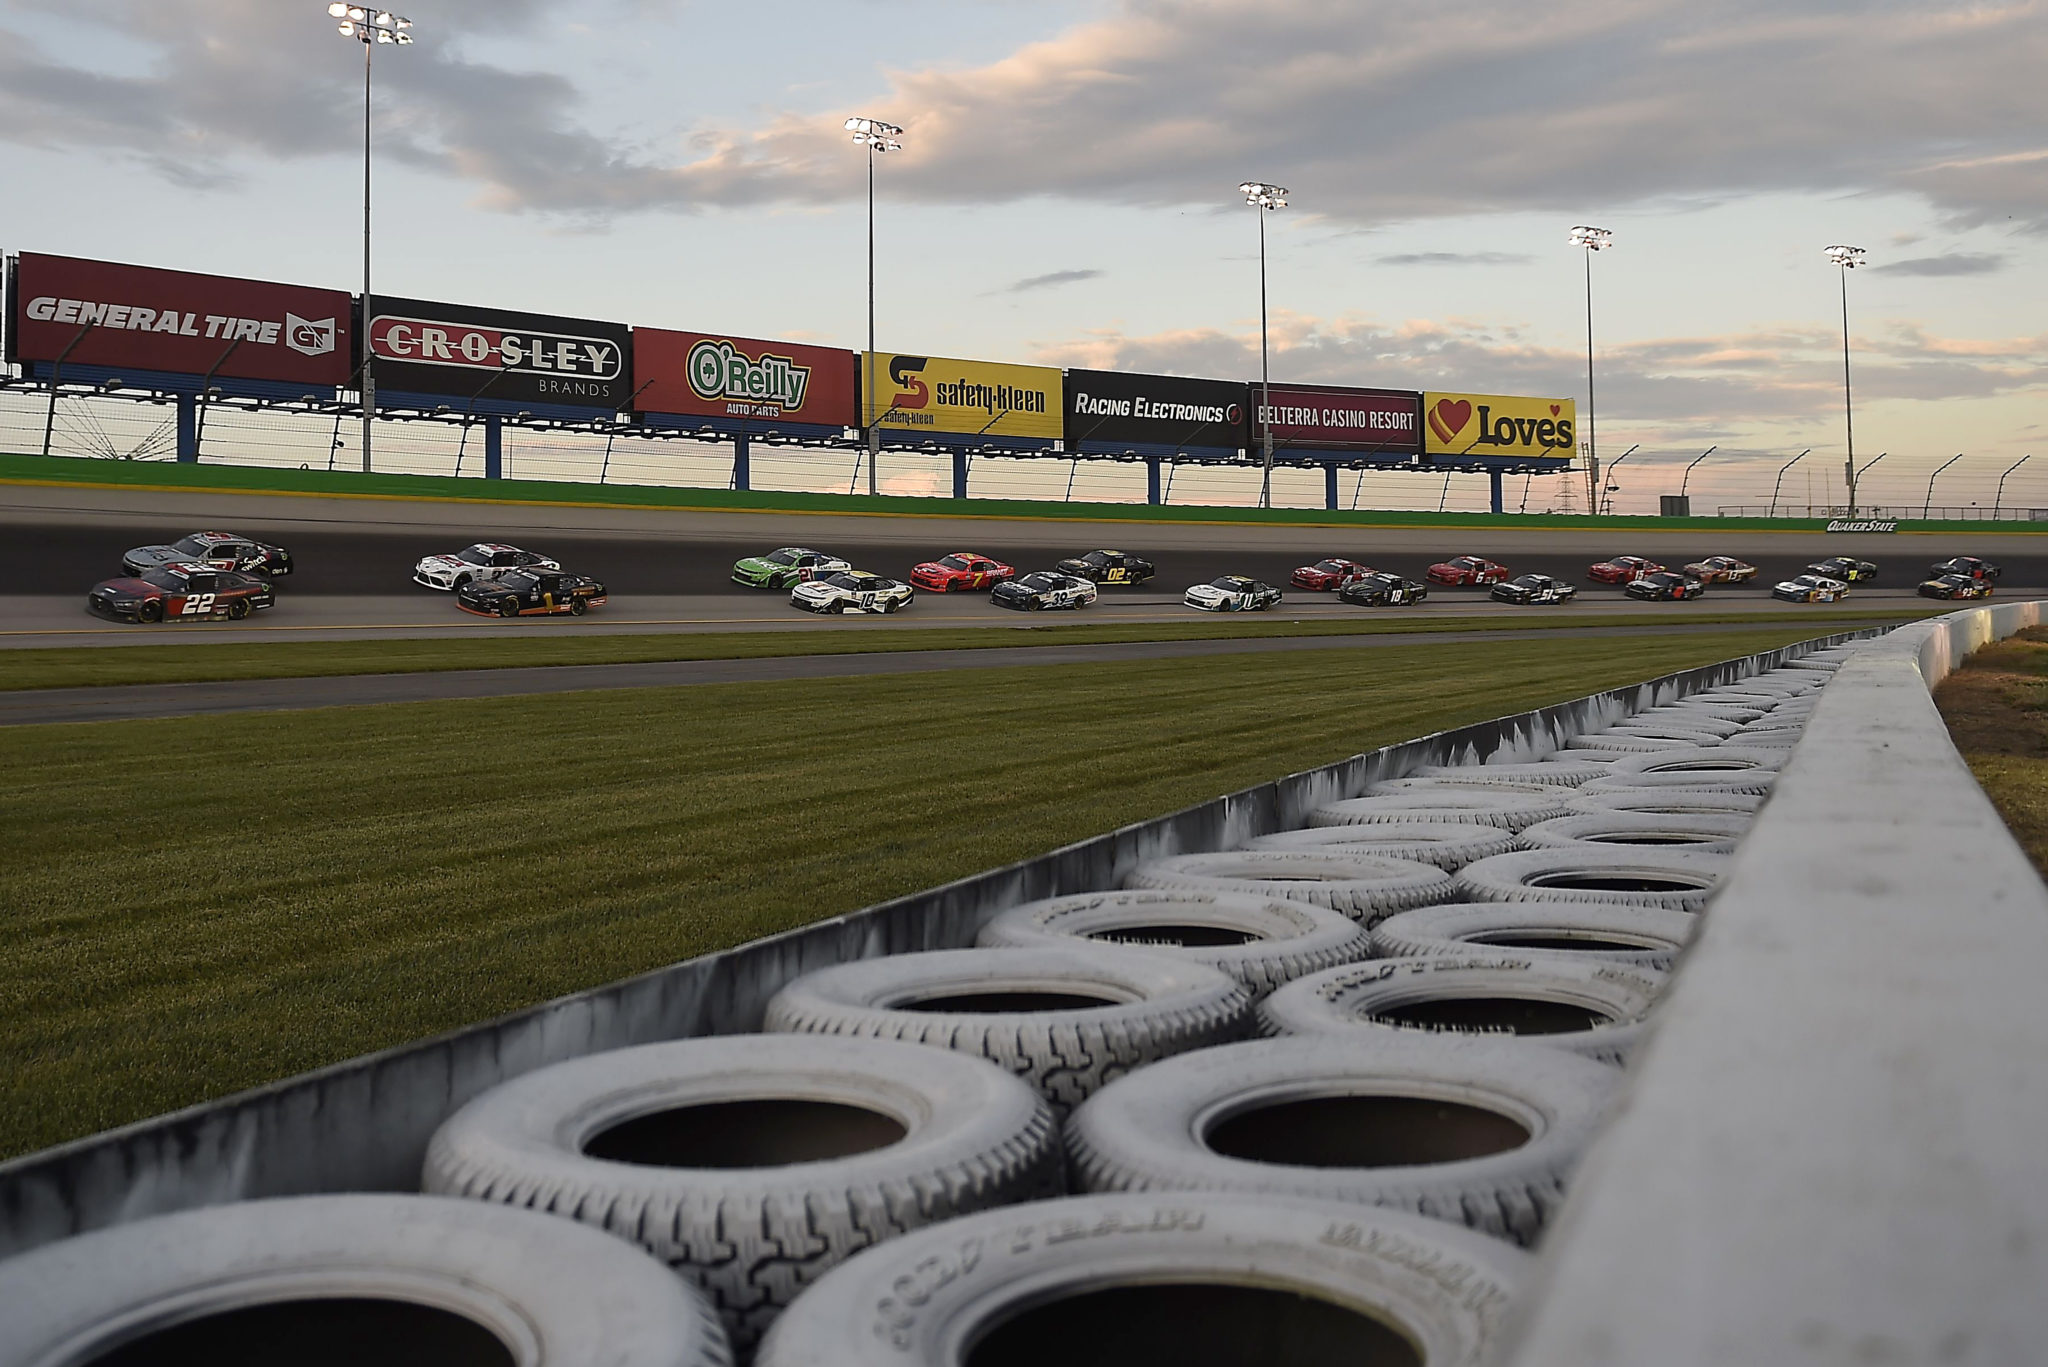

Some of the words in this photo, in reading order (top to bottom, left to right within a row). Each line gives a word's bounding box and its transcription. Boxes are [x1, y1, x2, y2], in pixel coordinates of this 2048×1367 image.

[26, 297, 198, 336] GENERAL
[205, 315, 282, 344] TIRE
[387, 325, 611, 373] CROSLEY
[693, 348, 803, 404] O'Reilly
[539, 379, 610, 397] BRANDS
[727, 403, 750, 415] AUTO
[1075, 393, 1131, 417] RACING
[1134, 397, 1224, 423] ELECTRONICS
[1258, 405, 1319, 426] BELTERRA
[1322, 409, 1365, 428] CASINO
[1370, 411, 1414, 430] RESORT
[799, 567, 813, 582] 21
[972, 572, 984, 587] 7
[1108, 567, 1125, 581] 02
[1475, 572, 1485, 583] 6
[543, 592, 554, 609] 1
[859, 592, 876, 609] 10
[1053, 592, 1068, 606] 39
[1390, 589, 1403, 603] 18
[1963, 588, 1973, 597] 93
[182, 593, 215, 614] 22
